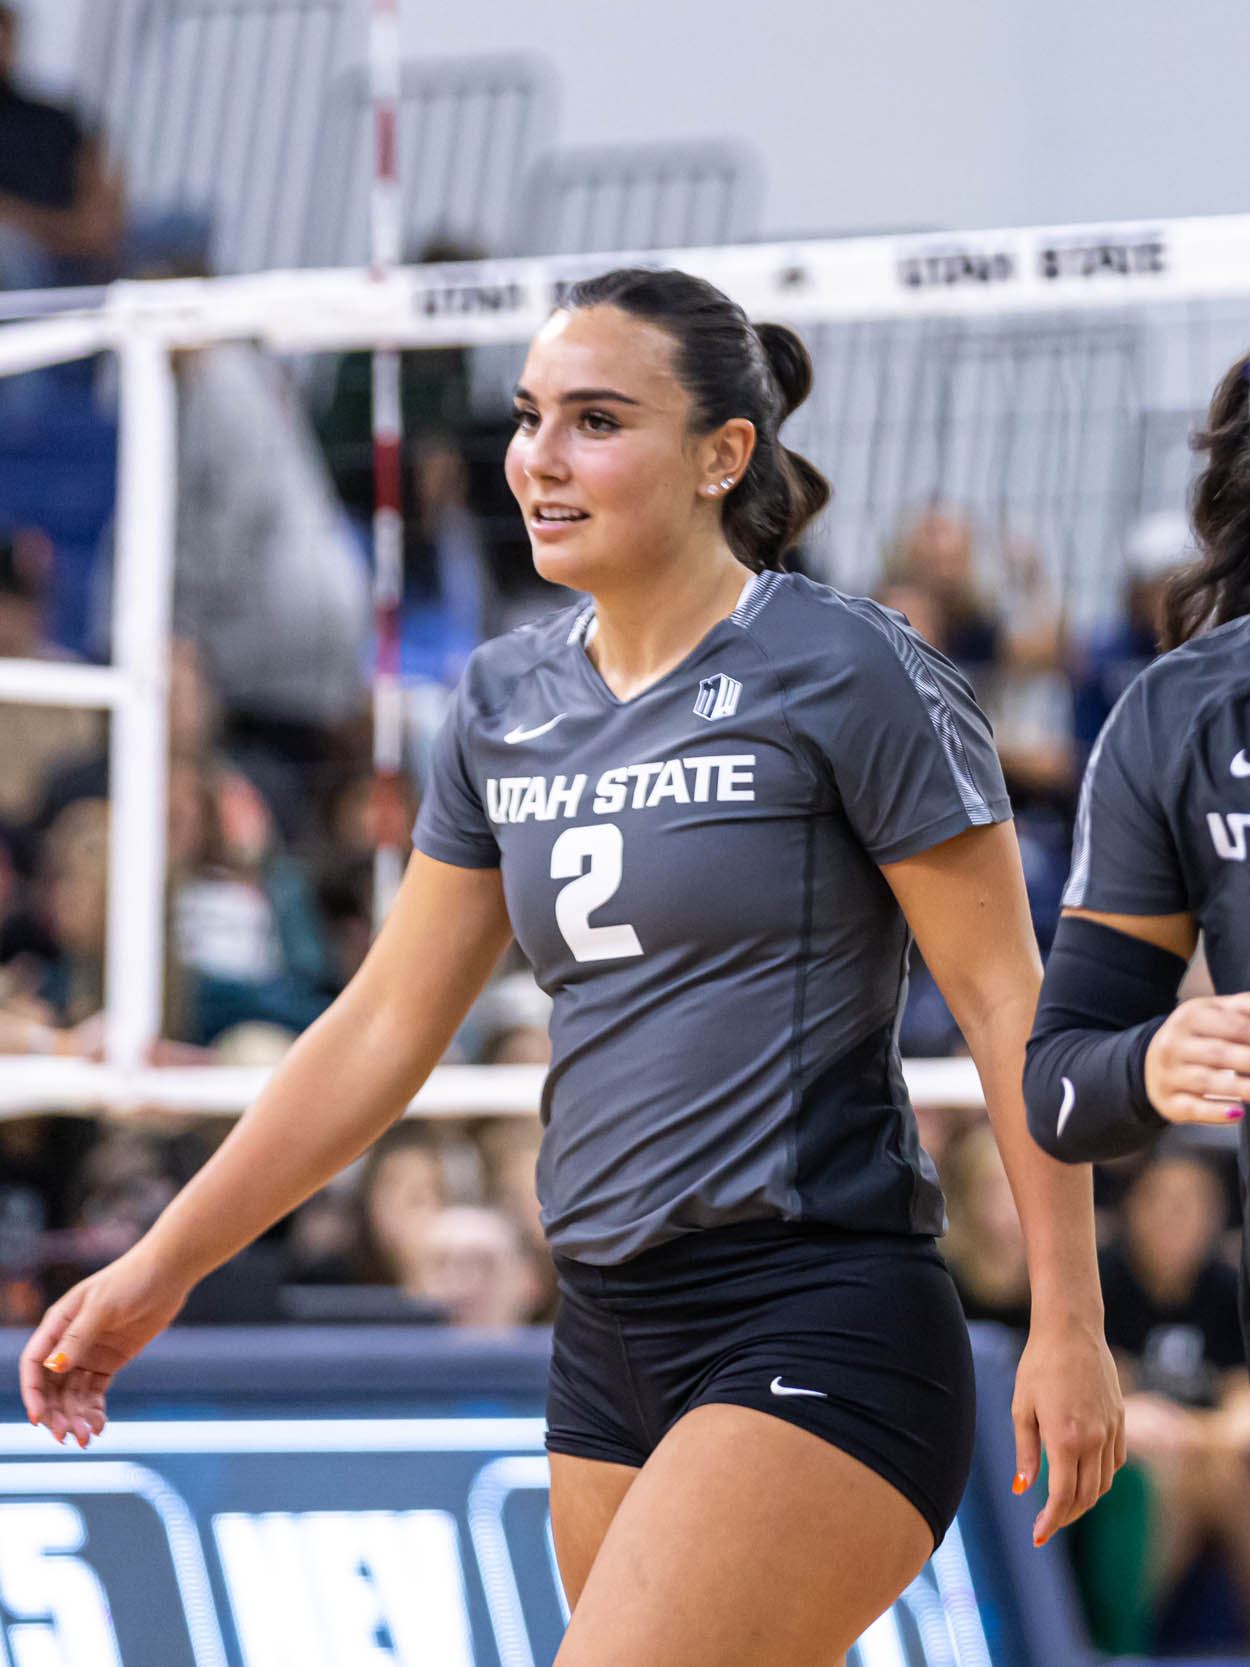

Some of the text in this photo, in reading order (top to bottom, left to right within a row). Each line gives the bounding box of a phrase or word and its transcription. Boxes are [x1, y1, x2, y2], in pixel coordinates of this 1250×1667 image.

[486, 754, 756, 824] UTAH STATE
[550, 823, 645, 962] 2
